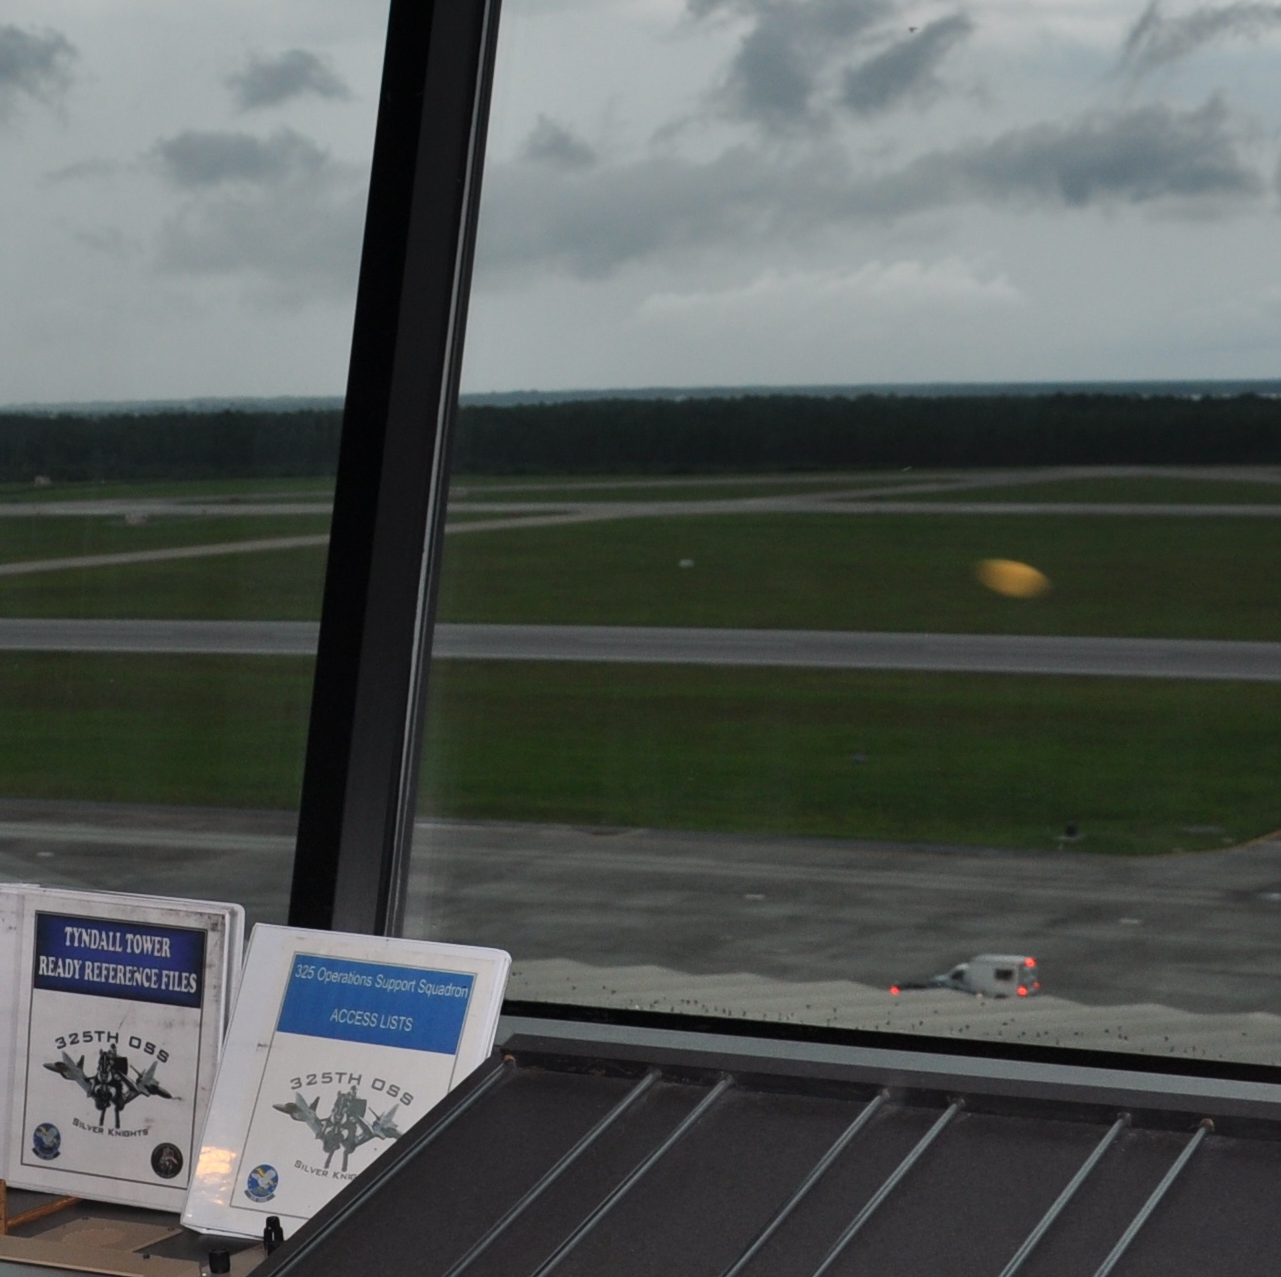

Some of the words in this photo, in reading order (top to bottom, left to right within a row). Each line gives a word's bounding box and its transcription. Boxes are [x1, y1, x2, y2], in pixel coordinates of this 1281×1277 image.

[64, 927, 122, 951] TYNDALL
[126, 934, 171, 957] TOWER
[39, 955, 82, 980] READY
[84, 961, 158, 989] REFERENCE
[161, 970, 197, 993] FILES
[295, 964, 315, 980] 325
[317, 967, 372, 988] Operations
[375, 974, 416, 993] Support
[418, 979, 468, 999] Squadron
[330, 1008, 378, 1028] ACCESS
[380, 1014, 414, 1032] LISTS
[54, 1030, 118, 1050] 325TH
[129, 1036, 170, 1063] OSS
[289, 1071, 362, 1090] 325TH
[371, 1077, 414, 1107] OSS
